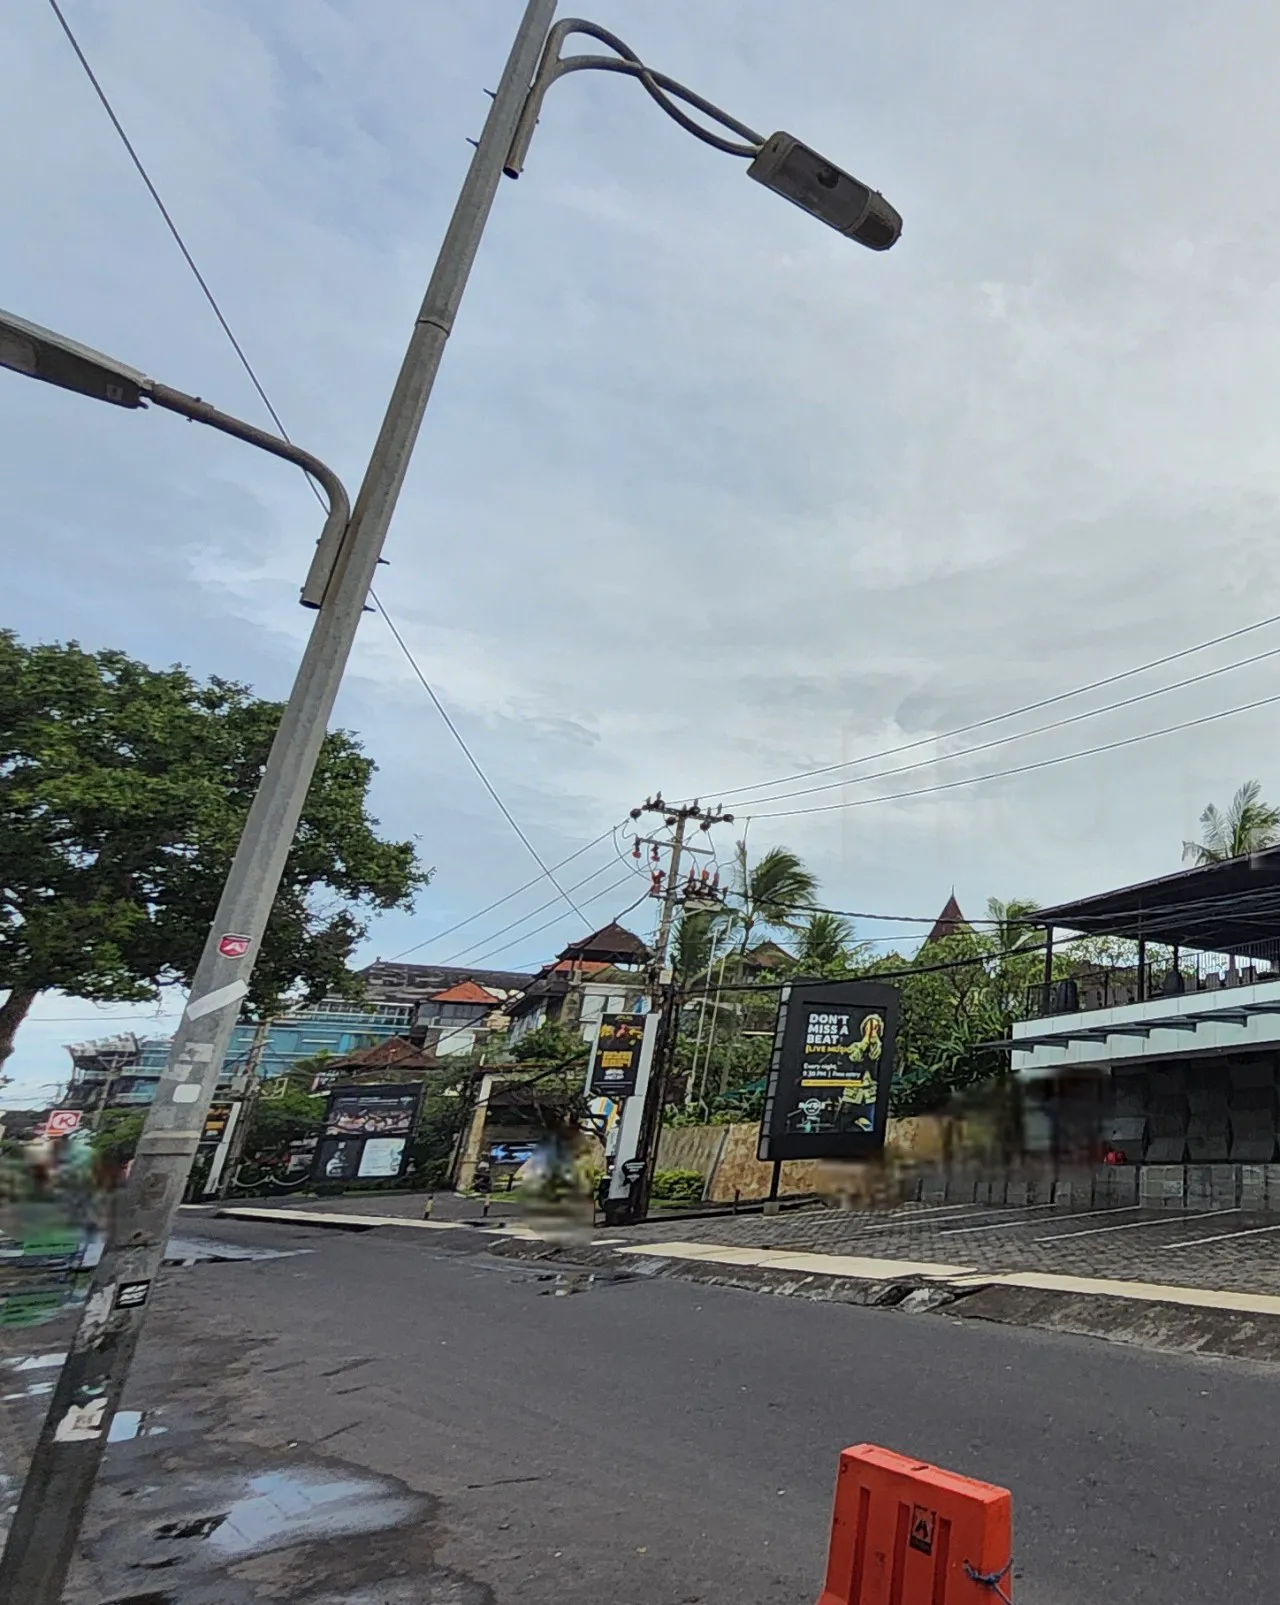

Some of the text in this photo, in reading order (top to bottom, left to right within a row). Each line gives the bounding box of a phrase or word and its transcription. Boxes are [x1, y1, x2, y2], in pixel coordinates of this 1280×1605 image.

[809, 1013, 849, 1025] DON'T
[807, 1024, 849, 1035] MISS A
[806, 1034, 839, 1045] BEAT
